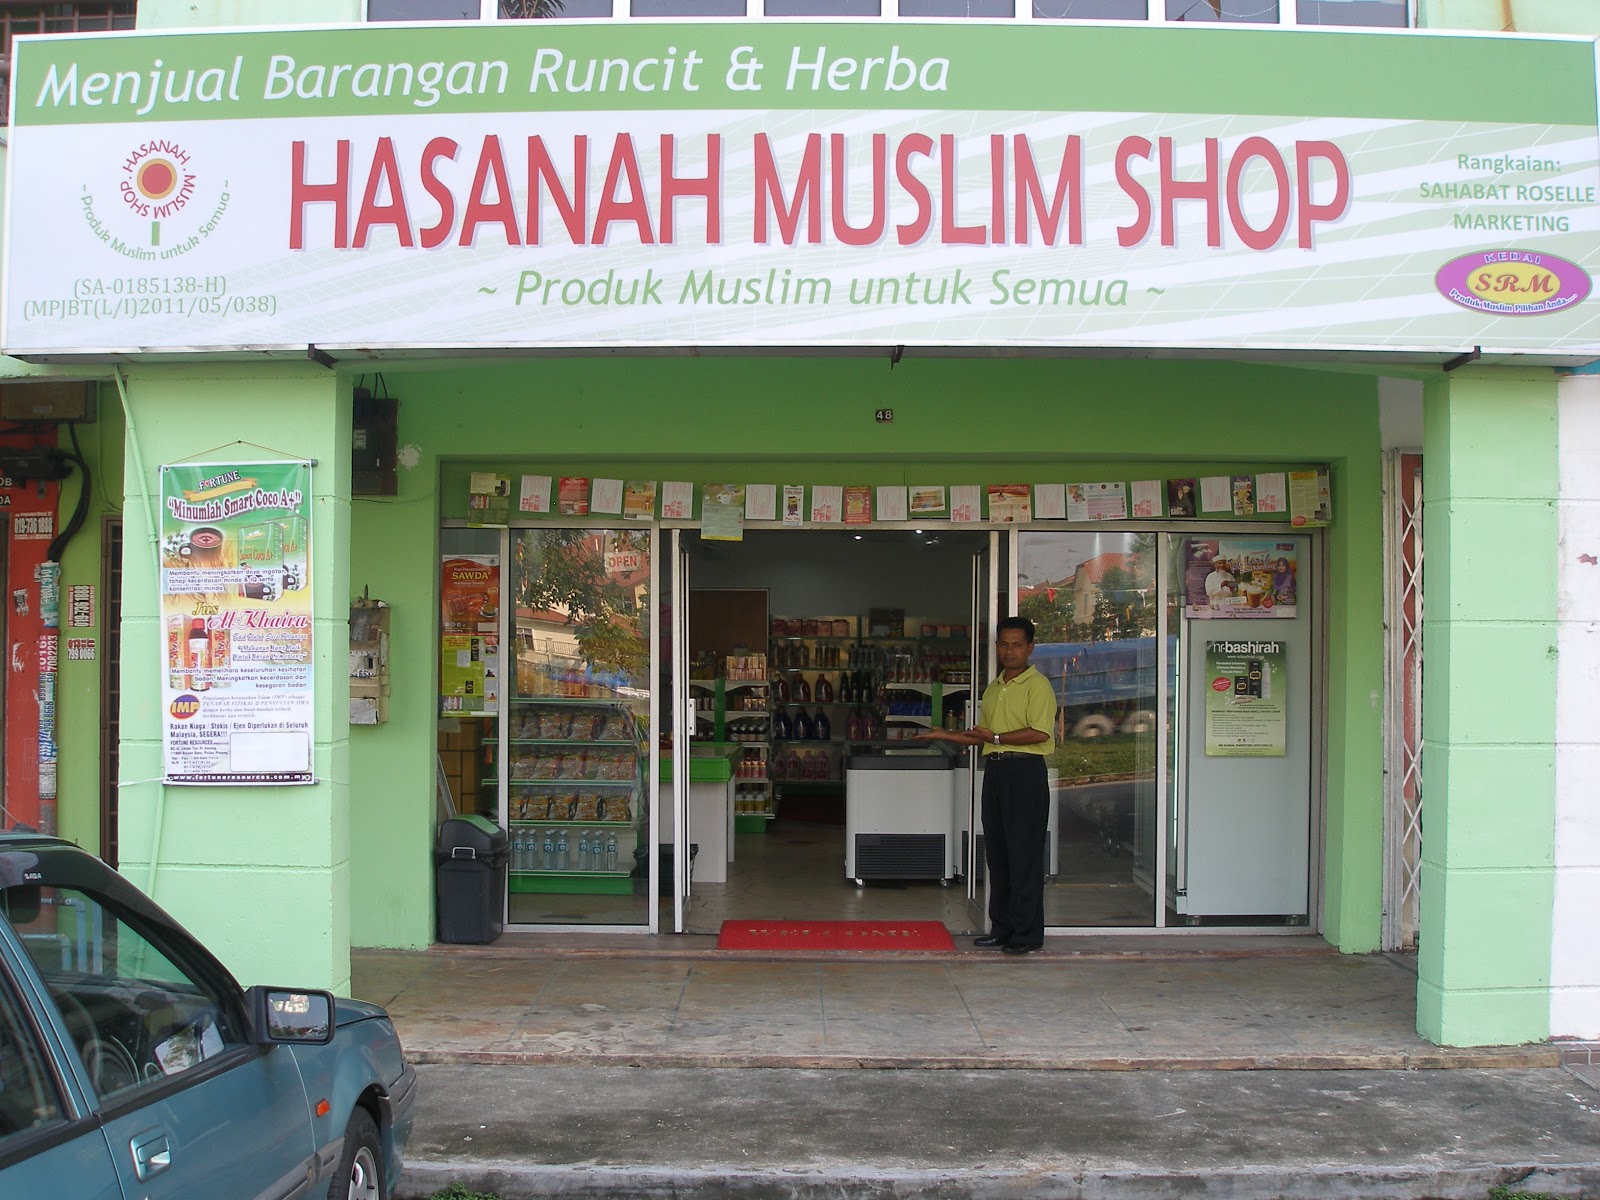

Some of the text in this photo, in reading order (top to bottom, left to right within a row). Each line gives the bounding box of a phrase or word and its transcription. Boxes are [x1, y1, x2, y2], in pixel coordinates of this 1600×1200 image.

[35, 45, 951, 116] Menjual Barangan Runcit & Herba
[122, 139, 191, 173] HASANAH
[1457, 154, 1561, 174] Rangkaian:
[120, 174, 196, 219] MUSLIM SHOP
[290, 133, 1350, 250] HASANAH MUSLIM SHOP
[1419, 182, 1596, 203] SAHABAT ROSELLE
[80, 191, 230, 261] Produk Muslim untuk Semua
[1454, 213, 1569, 232] MARKETING
[1484, 252, 1542, 265] KEDAI
[74, 275, 227, 299] (SA-0185138-H)
[514, 268, 1129, 306] Produk Muslim untuk Semua
[1474, 273, 1554, 293] SRM
[24, 295, 277, 321] (MPJBT(L/I)2011/05/038)
[1449, 288, 1482, 308] Produk
[1482, 301, 1513, 313] Muslim
[1514, 303, 1545, 313] Pilihan
[876, 410, 892, 420] 48
[224, 494, 253, 516] Smart
[256, 489, 278, 507] Coco
[608, 556, 637, 567] OPEN
[202, 569, 244, 578] meningkatkan
[74, 585, 89, 600] 1888
[74, 602, 89, 626] 019-736
[192, 602, 219, 615] Jus
[208, 610, 308, 629] Al-Khaira
[47, 635, 58, 671] 7082233
[1213, 641, 1280, 654] nr-bashirah
[171, 701, 200, 713] IMP
[233, 722, 246, 730] Ejen
